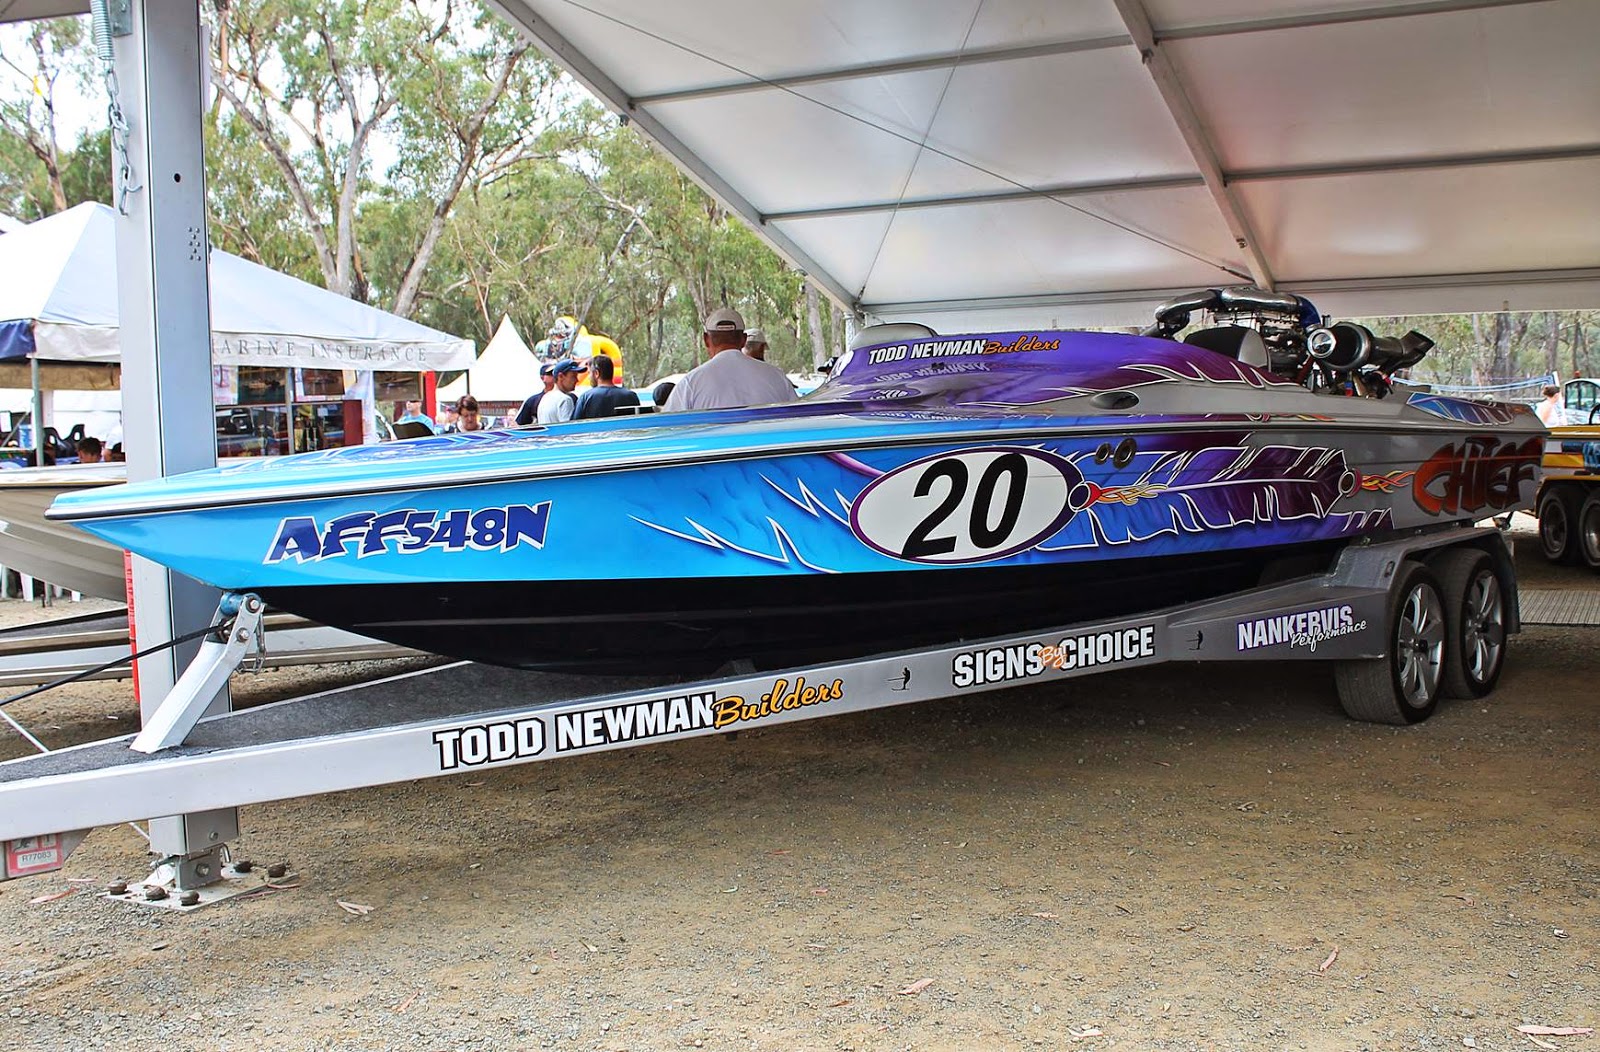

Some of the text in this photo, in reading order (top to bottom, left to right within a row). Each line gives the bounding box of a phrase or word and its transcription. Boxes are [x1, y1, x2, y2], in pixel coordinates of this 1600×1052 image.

[212, 339, 427, 362] ARINE INSURANCE
[869, 335, 1060, 365] TODD NEWMAN Builders
[262, 500, 552, 565] AFF548N
[900, 453, 1029, 559] 20
[1237, 605, 1353, 651] NANKERVIS
[1290, 619, 1367, 652] Performance
[952, 624, 1155, 688] SIGNS By CHOICE
[432, 677, 843, 771] TODD NEWMAN Builders
